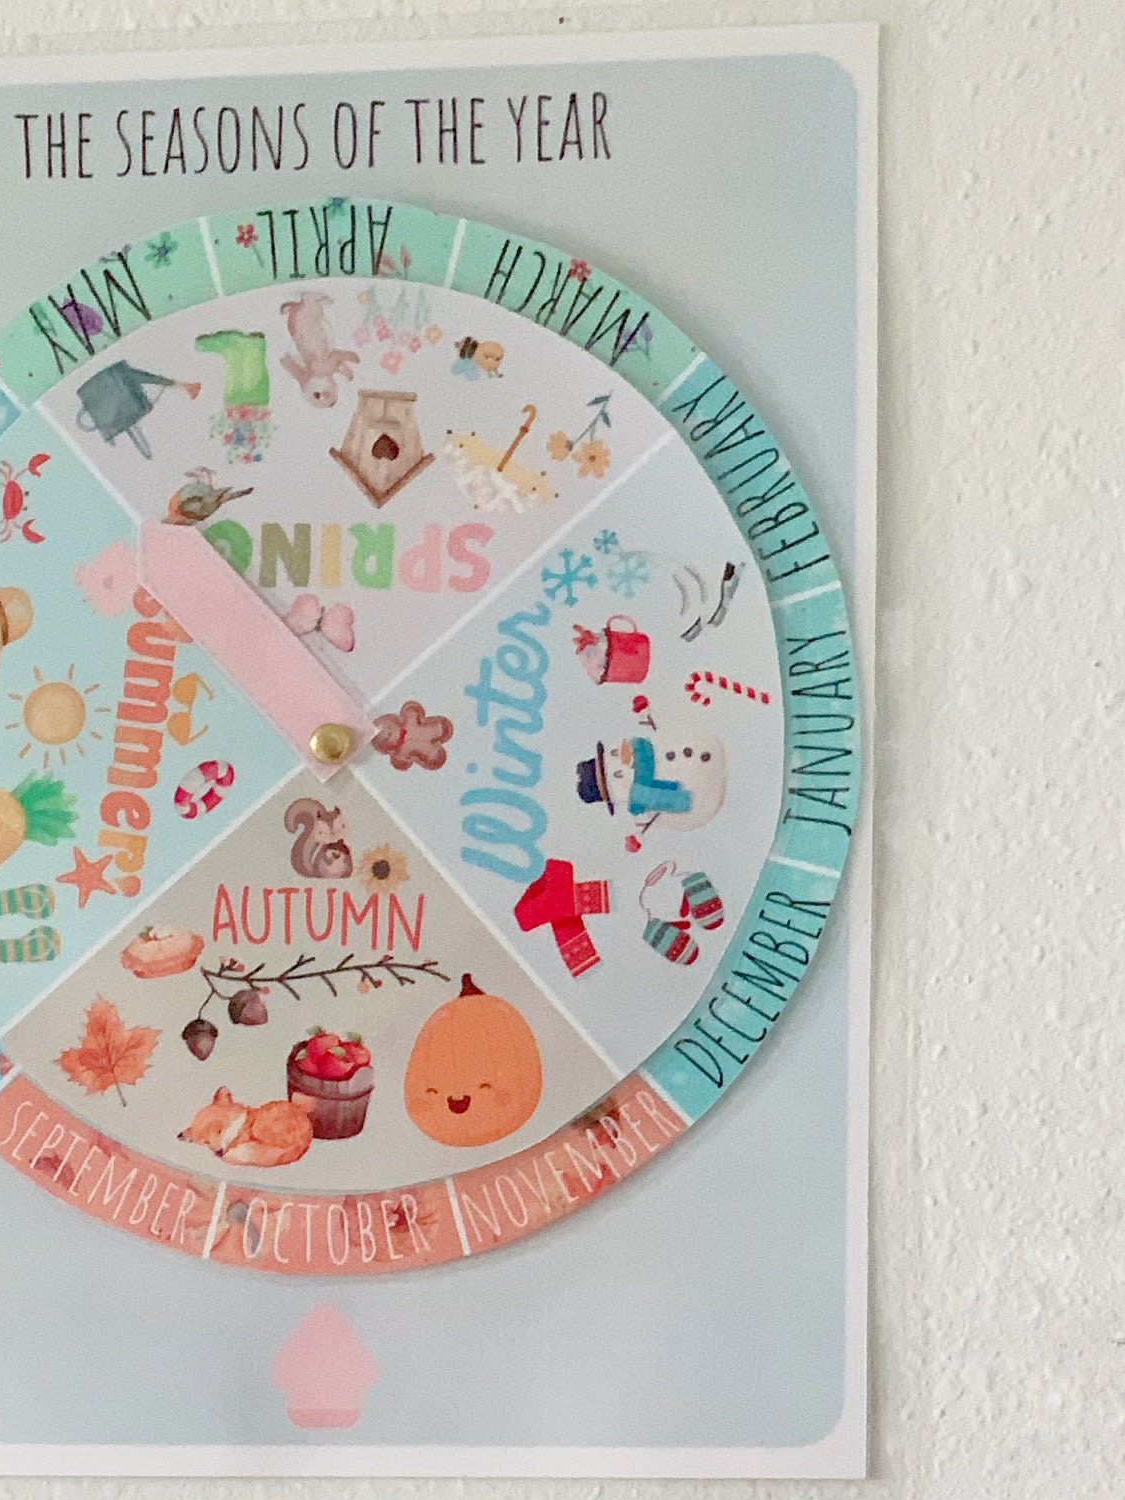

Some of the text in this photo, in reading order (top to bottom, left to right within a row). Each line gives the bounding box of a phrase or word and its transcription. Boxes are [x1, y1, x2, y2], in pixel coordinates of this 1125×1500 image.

[15, 91, 612, 179] THE SEASONS OF THE YEAR
[257, 205, 394, 279] APRIL
[489, 238, 651, 368] MARCH
[27, 251, 153, 376] MAY
[672, 374, 831, 584] FEBRUARY
[460, 601, 552, 884] Winter
[783, 627, 854, 837] JANUARY
[212, 884, 426, 953] AUTUMN
[673, 889, 832, 1090] DECEMBER
[9, 1100, 199, 1244] SEPTEMBER
[243, 1190, 433, 1267] OCTOBER
[458, 1088, 684, 1244] NOVEMBER
